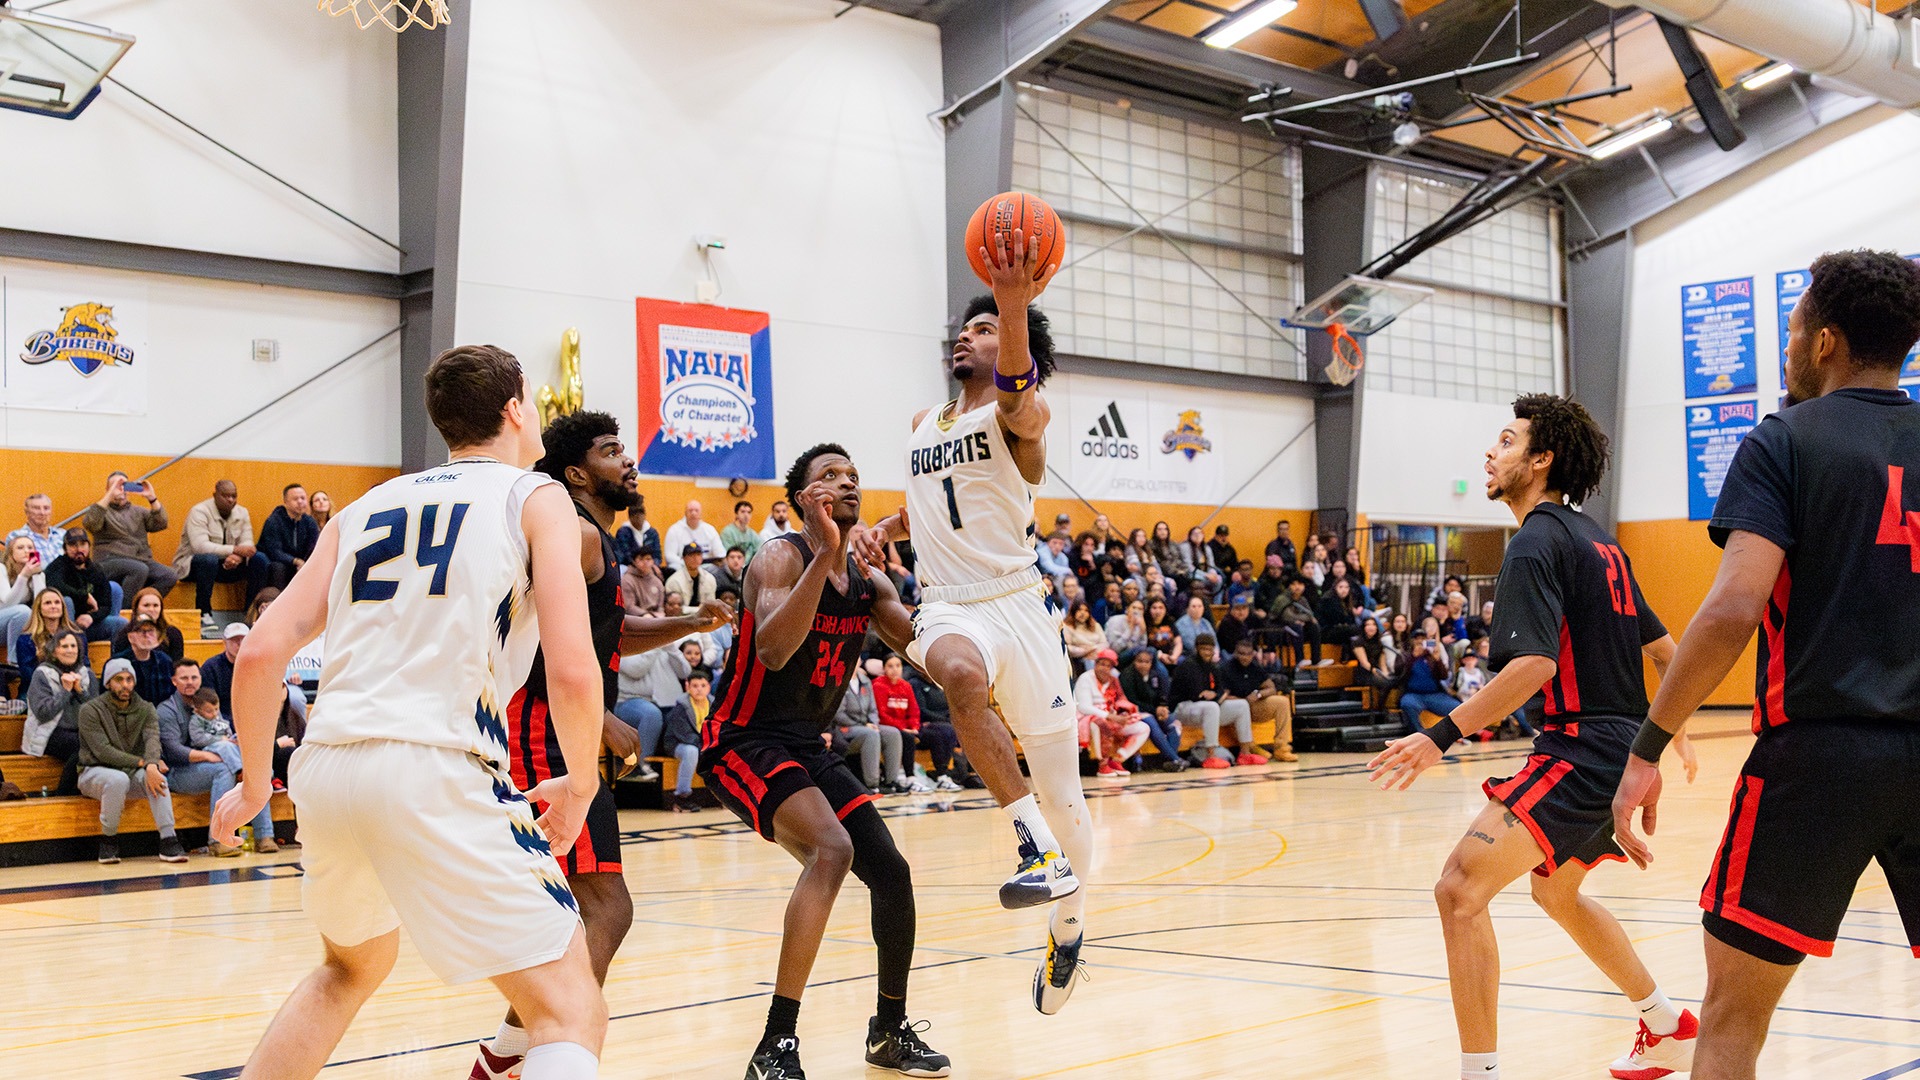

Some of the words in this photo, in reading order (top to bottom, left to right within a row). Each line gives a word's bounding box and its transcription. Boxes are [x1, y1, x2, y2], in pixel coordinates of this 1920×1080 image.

[665, 347, 747, 393] NAIA
[673, 409, 685, 419] of
[688, 409, 742, 423] Character
[677, 394, 738, 409] Champions
[1720, 404, 1753, 420] NAIA
[911, 431, 991, 477] BOBCATS
[1081, 436, 1139, 460] adidas
[415, 475, 437, 483] CAL
[437, 472, 462, 481] PAC
[942, 476, 963, 530] 1
[350, 502, 473, 606] 24
[1592, 541, 1637, 616] 21
[810, 613, 871, 635] EDHAWKS
[810, 640, 846, 687] 24
